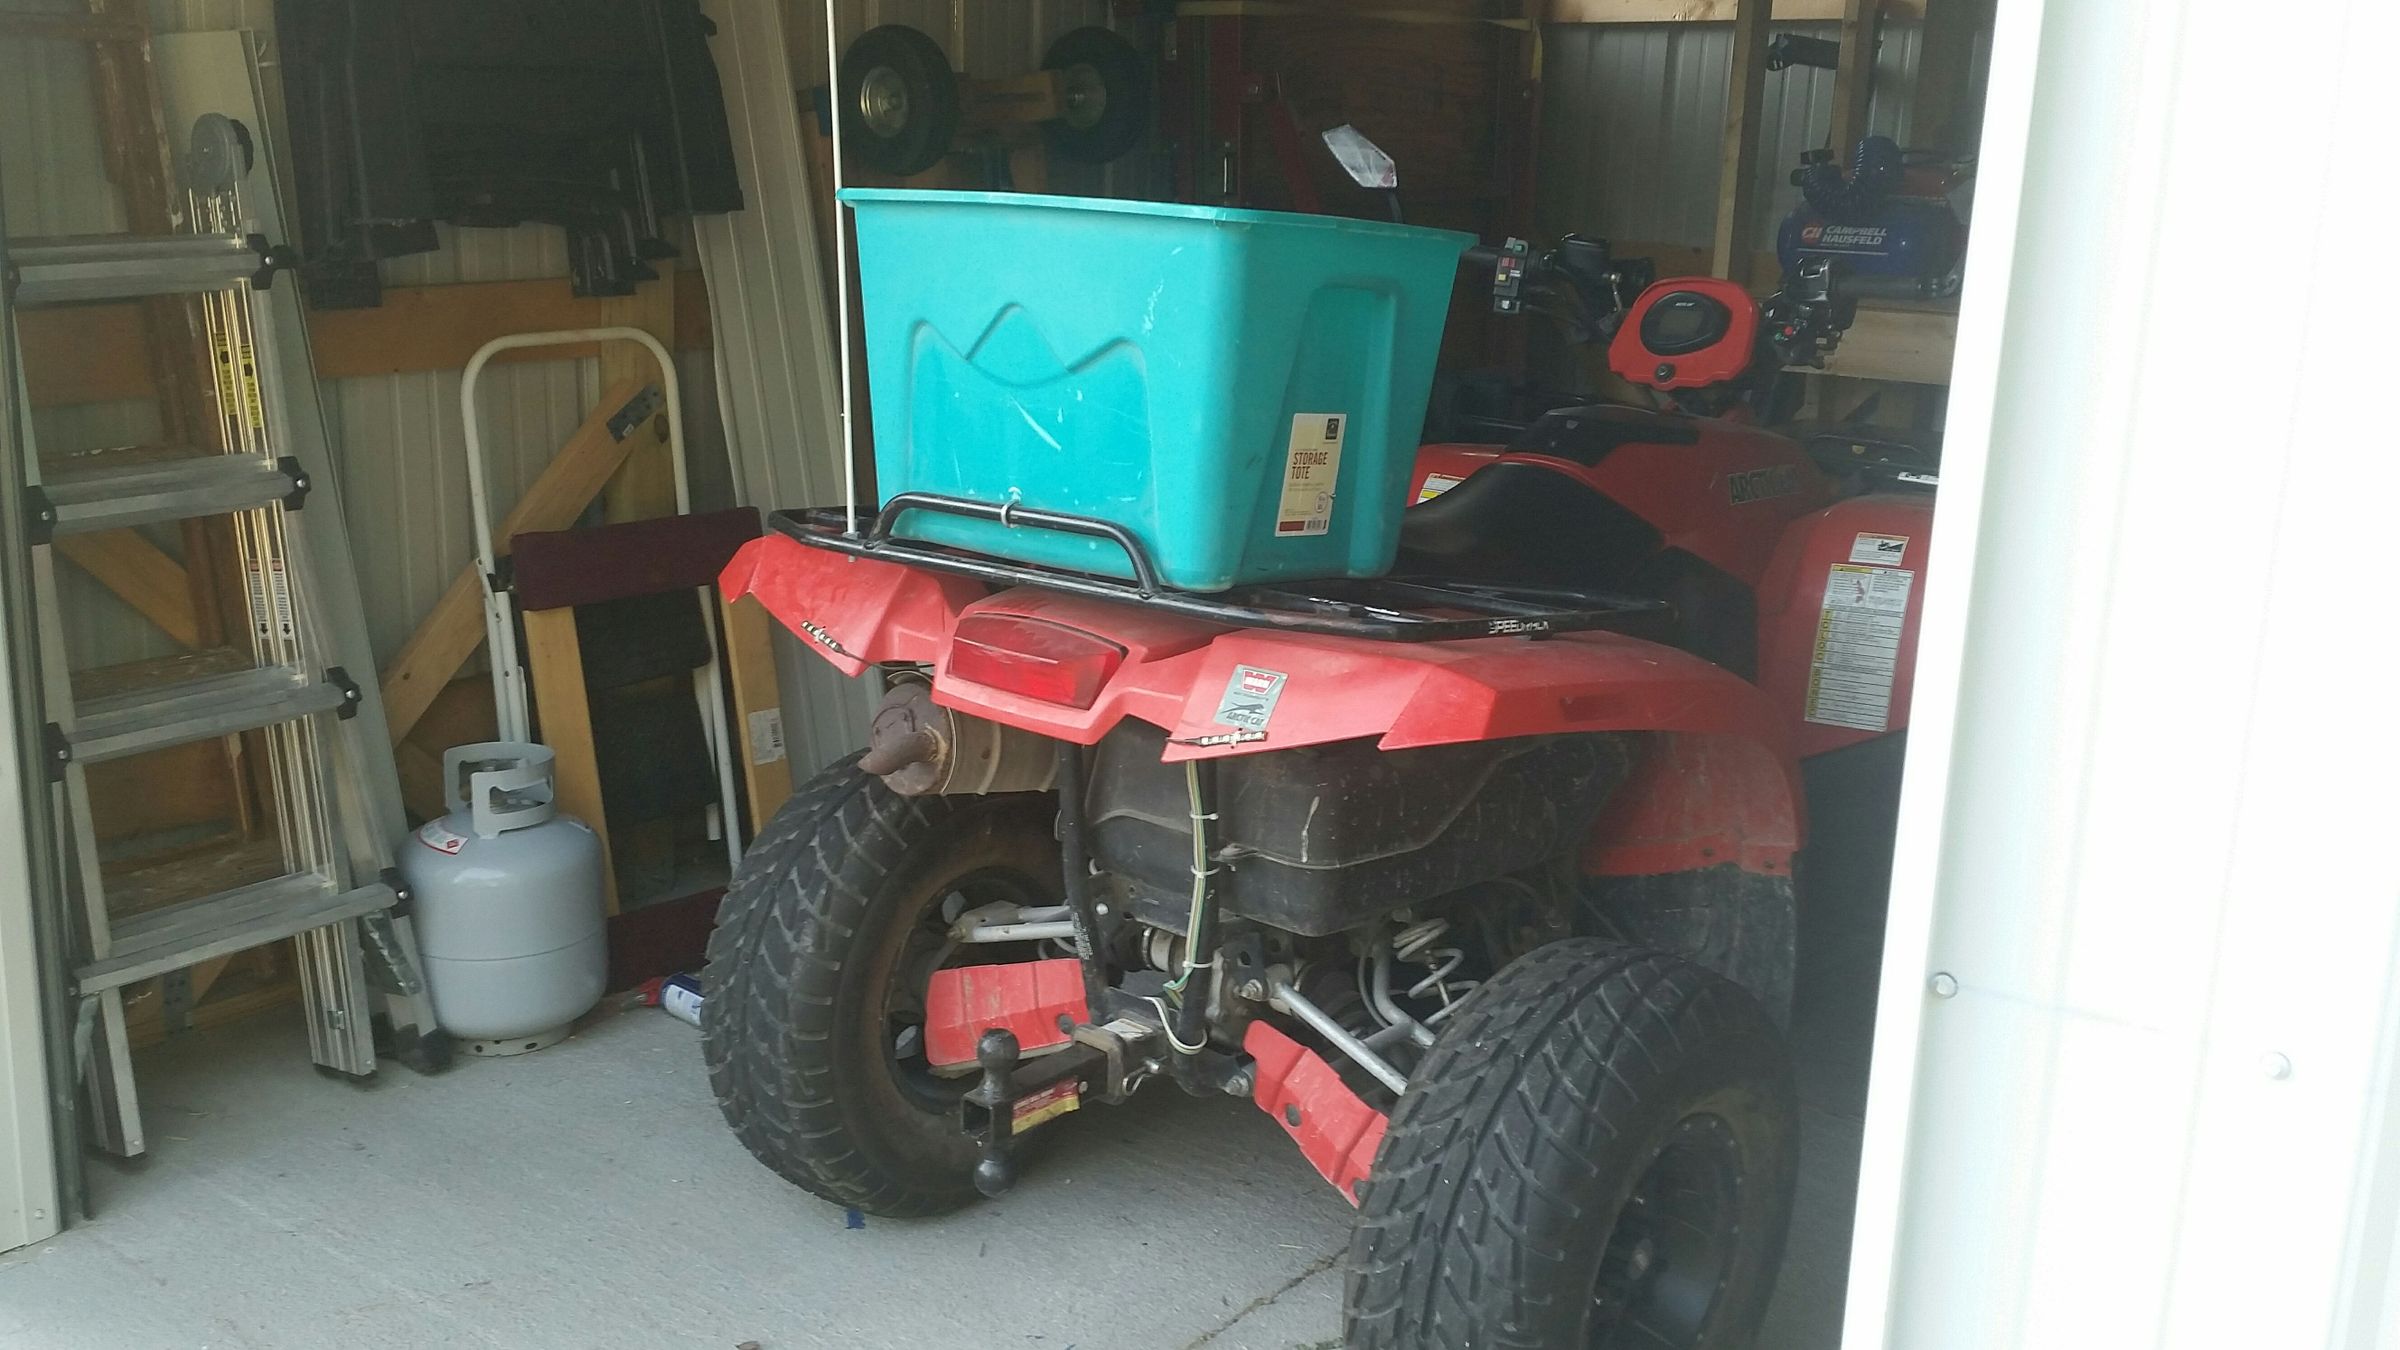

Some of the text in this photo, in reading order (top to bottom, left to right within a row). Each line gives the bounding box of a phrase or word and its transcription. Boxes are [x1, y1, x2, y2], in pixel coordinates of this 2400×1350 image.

[1826, 225, 1887, 237] CAMPBELL
[1822, 234, 1883, 245] HAUSFELD
[1293, 452, 1328, 465] STORAGE
[1291, 466, 1311, 480] TOTE
